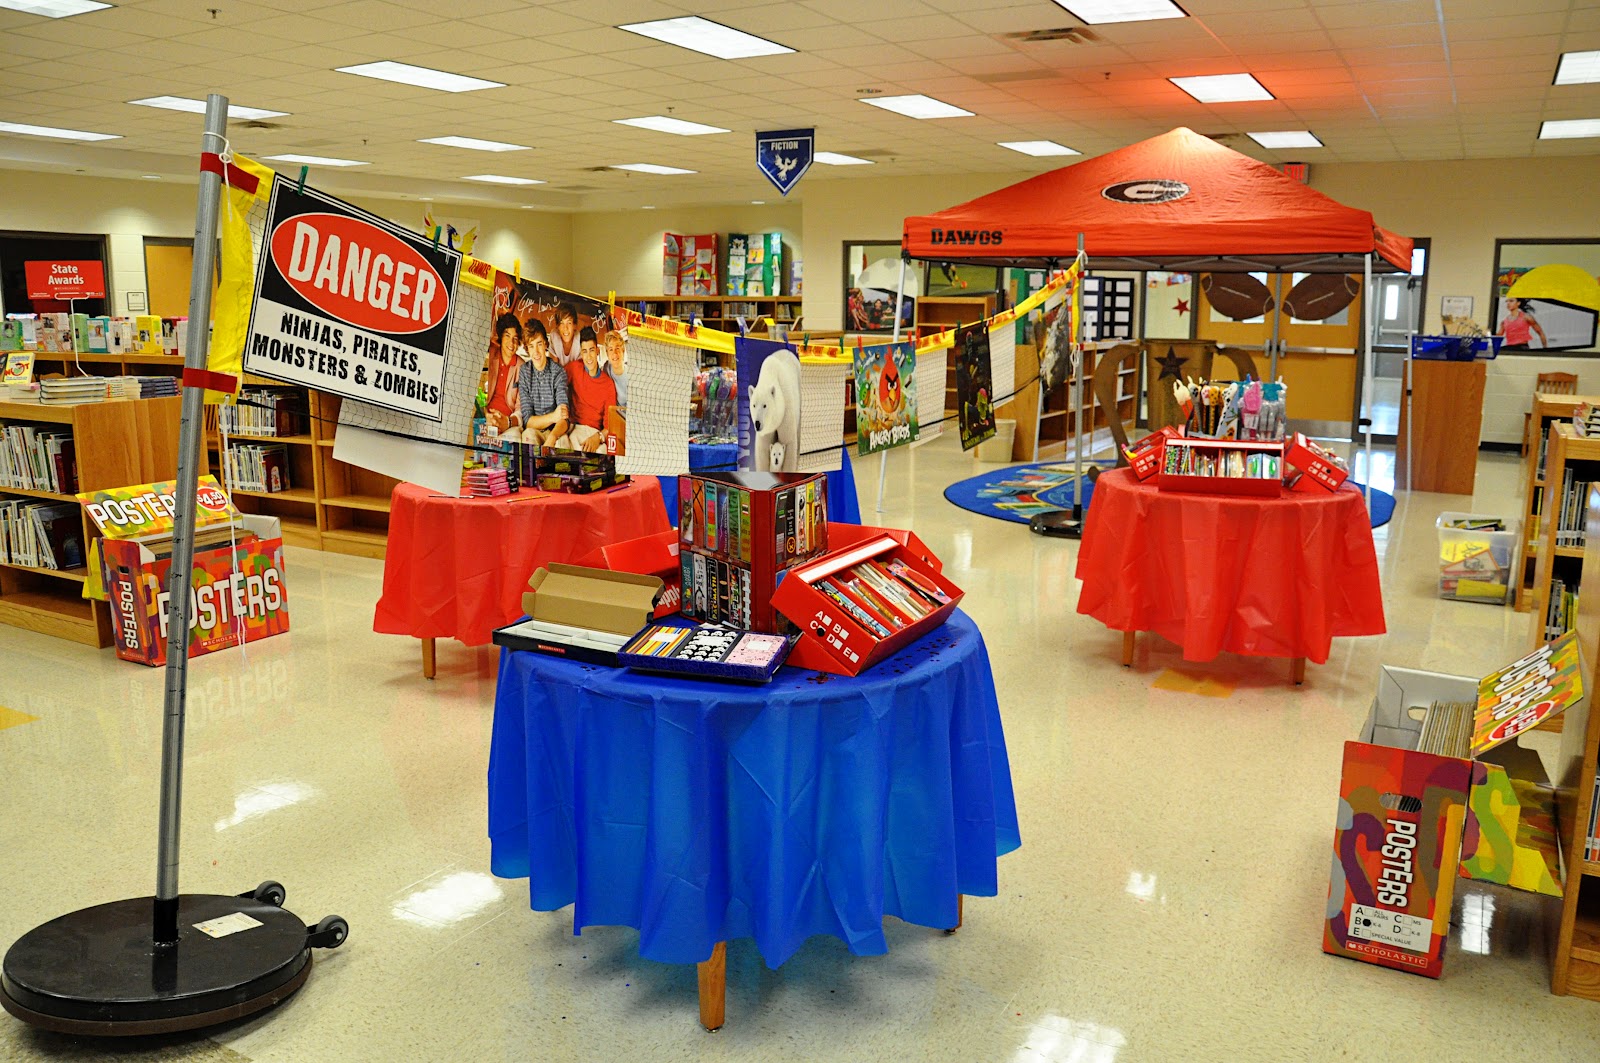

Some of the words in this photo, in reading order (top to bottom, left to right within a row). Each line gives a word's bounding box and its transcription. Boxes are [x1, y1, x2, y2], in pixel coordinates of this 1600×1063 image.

[771, 141, 799, 151] FICTION
[931, 228, 1003, 245] DAWGS
[48, 275, 84, 285] Awards
[51, 264, 78, 274] State
[288, 221, 437, 325] DANGER
[280, 312, 347, 354] NINJAS,
[353, 334, 422, 376] PIRATES,
[251, 333, 349, 380] MONSTERS
[354, 364, 368, 386] &
[374, 369, 439, 405] ZOMBIES
[869, 429, 892, 451] ANGRY
[891, 423, 911, 444] BIRDS
[118, 580, 139, 650] POSTERS
[815, 610, 824, 620] A
[832, 623, 842, 634] B
[810, 620, 819, 630] C
[826, 633, 836, 644] D
[843, 646, 852, 658] E
[1492, 644, 1556, 720] POSTERS
[1376, 819, 1417, 908] POSTERS
[1354, 916, 1362, 925] B
[1392, 925, 1402, 934] D
[1355, 906, 1364, 916] A
[1393, 915, 1402, 924] C
[1353, 927, 1360, 936] E
[1371, 932, 1393, 941] SPECIAL
[1394, 937, 1412, 946] VALUE
[1357, 944, 1425, 966] SCHOLASTIC
